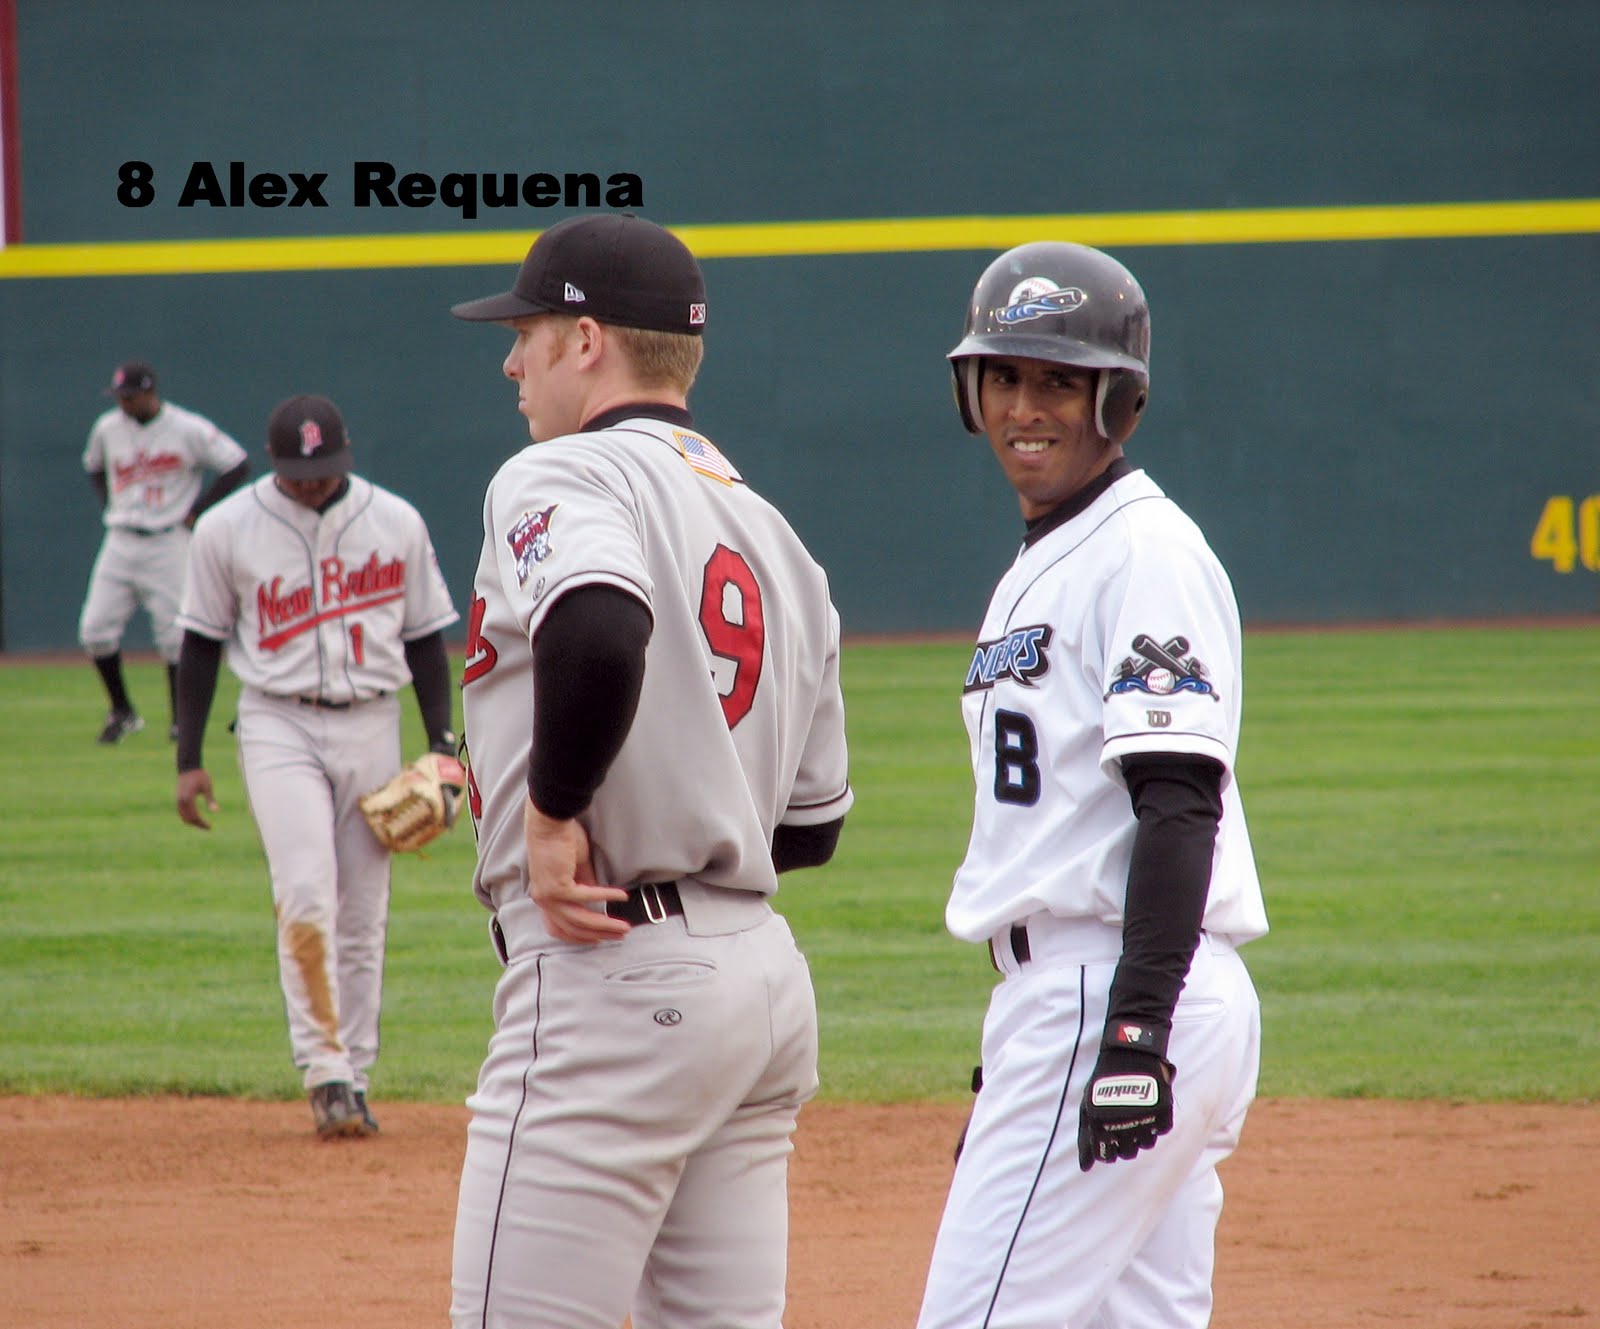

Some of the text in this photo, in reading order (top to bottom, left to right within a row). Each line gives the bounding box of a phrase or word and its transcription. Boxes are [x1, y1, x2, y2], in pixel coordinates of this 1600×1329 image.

[257, 576, 314, 635] New
[350, 622, 364, 665] 1
[699, 543, 765, 730] 9
[994, 708, 1041, 808] 8
